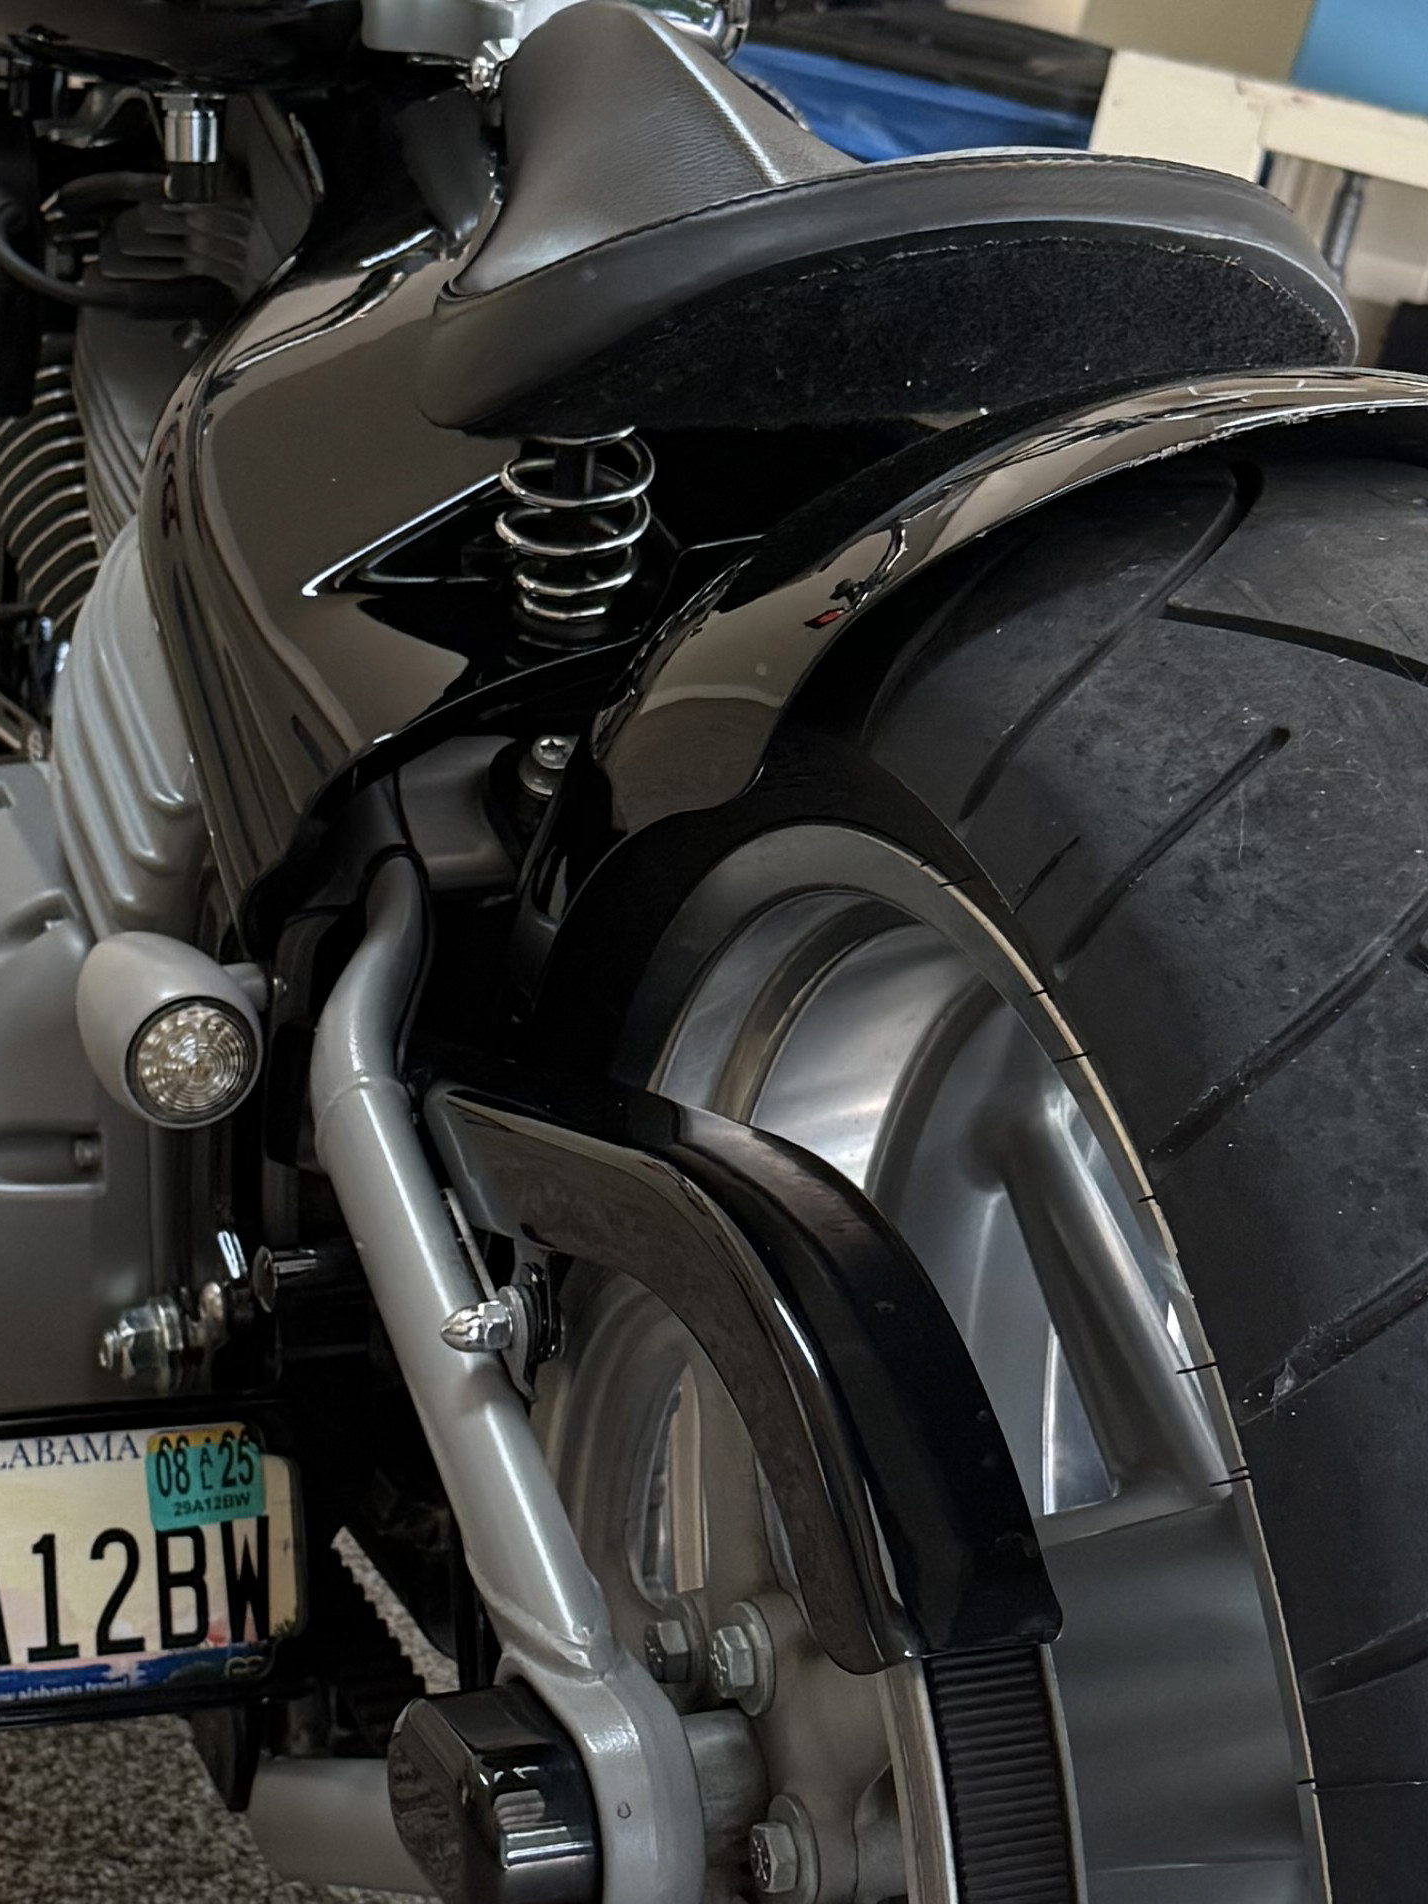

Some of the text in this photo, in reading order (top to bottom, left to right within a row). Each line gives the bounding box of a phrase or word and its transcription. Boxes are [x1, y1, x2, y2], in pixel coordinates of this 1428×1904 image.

[156, 1444, 190, 1497] 08
[218, 1438, 254, 1487] 25
[173, 1492, 251, 1517] 29A12BW
